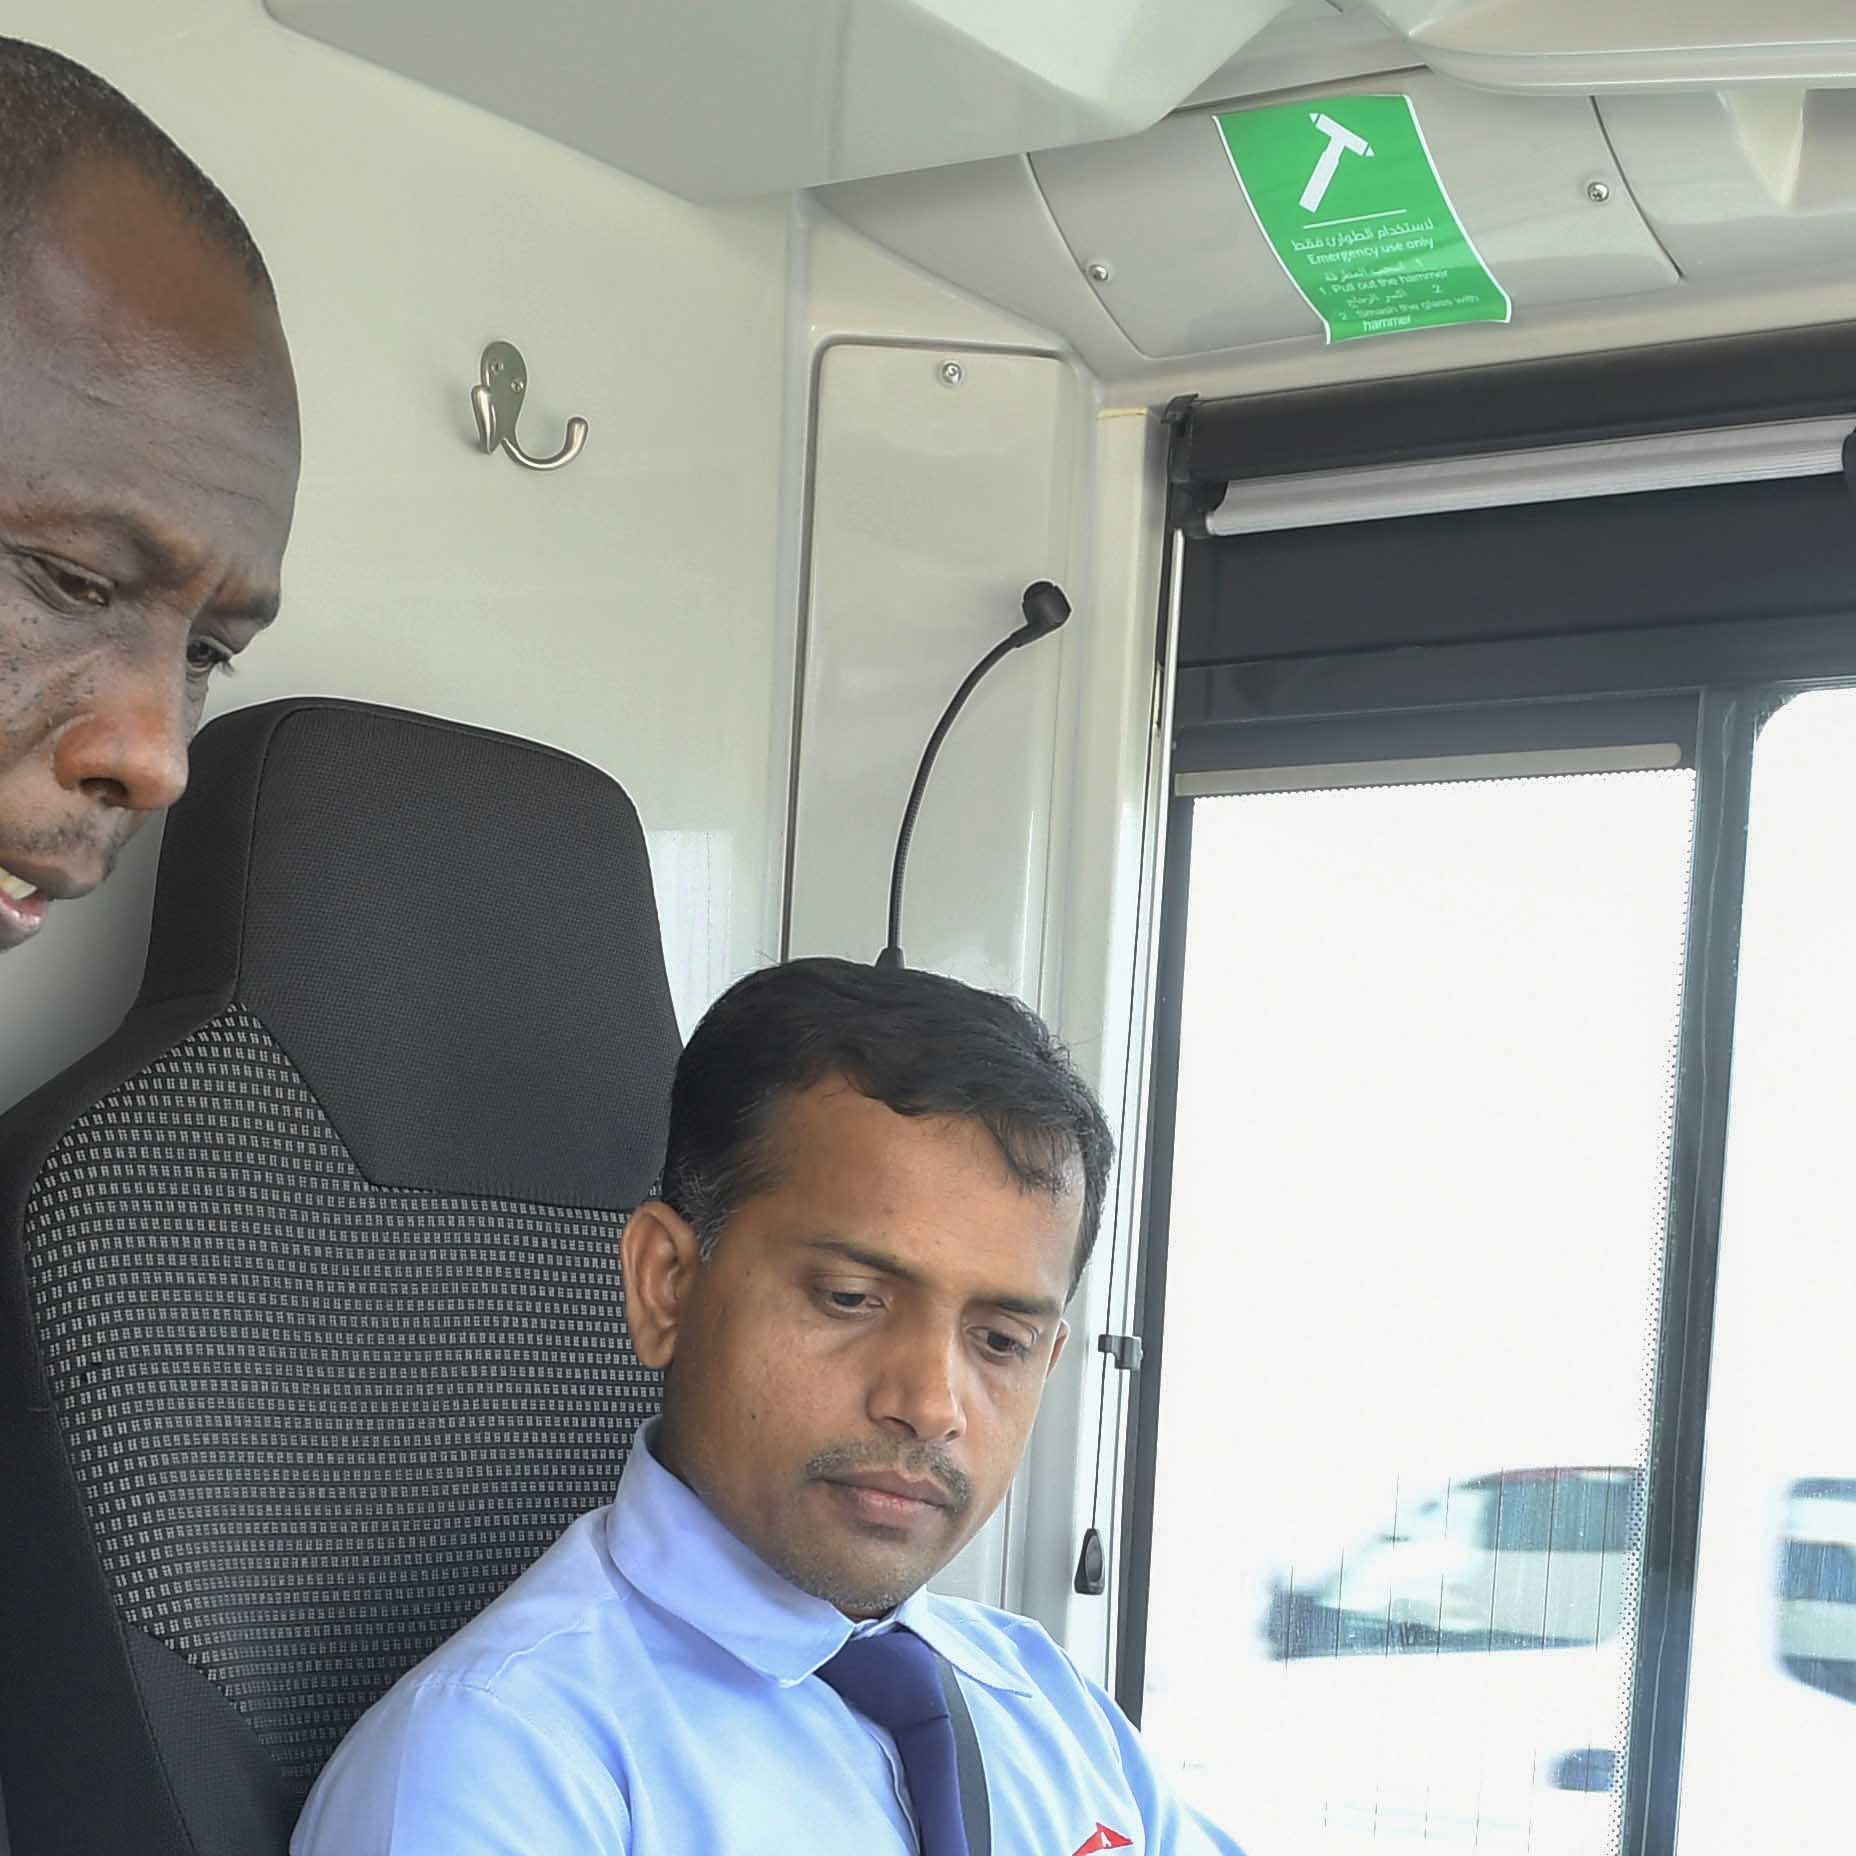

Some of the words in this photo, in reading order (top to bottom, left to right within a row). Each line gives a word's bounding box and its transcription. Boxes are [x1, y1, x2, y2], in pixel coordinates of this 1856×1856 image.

[1307, 246, 1379, 265] Emergency
[1381, 242, 1404, 254] use
[1405, 236, 1435, 250] only
[1331, 281, 1356, 294] Pull
[1378, 275, 1398, 288] the
[1398, 270, 1449, 285] hammer
[1362, 314, 1412, 333] hammer
